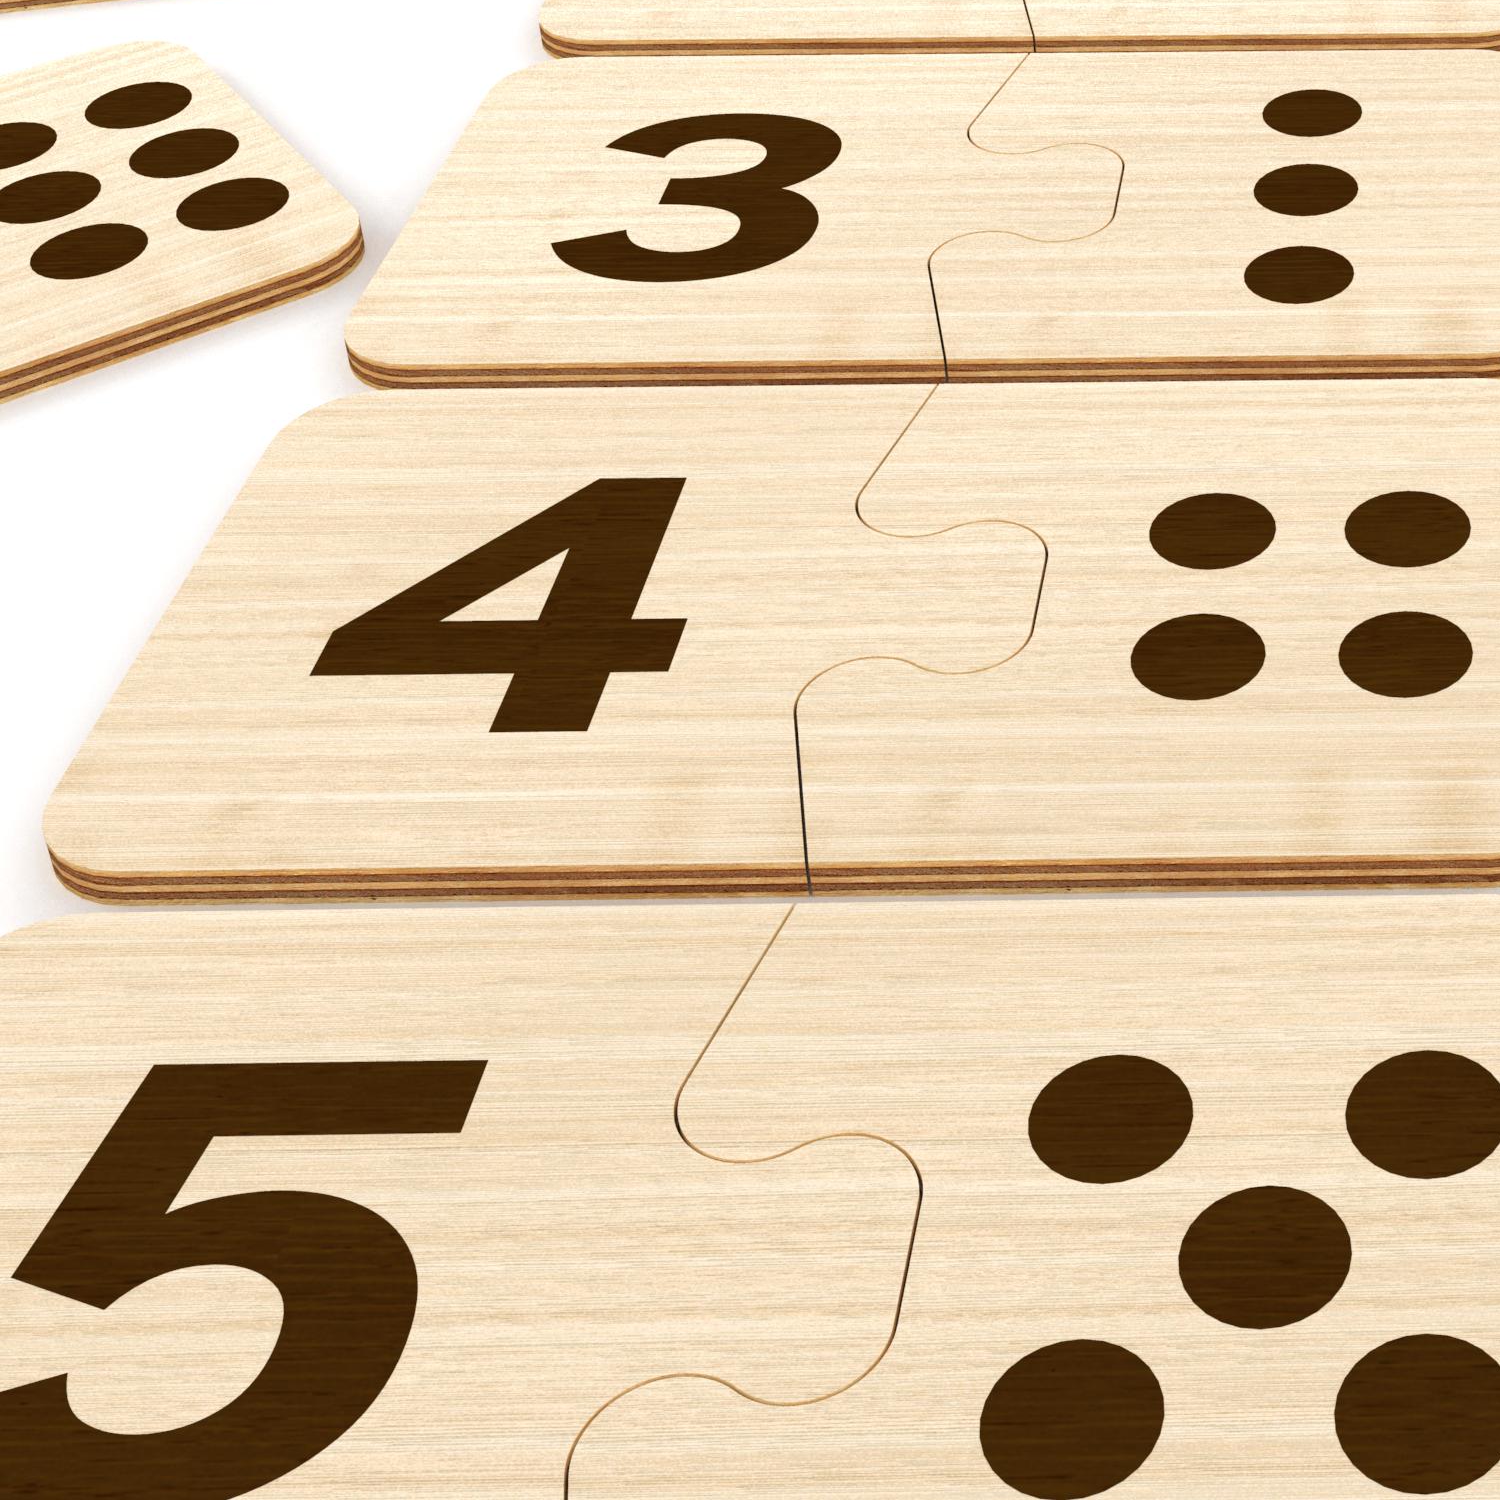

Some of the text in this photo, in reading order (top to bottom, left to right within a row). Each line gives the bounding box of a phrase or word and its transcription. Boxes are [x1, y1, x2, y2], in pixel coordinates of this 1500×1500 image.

[551, 113, 842, 283] 3
[310, 477, 688, 733] 4
[0, 1059, 489, 1500] 5
